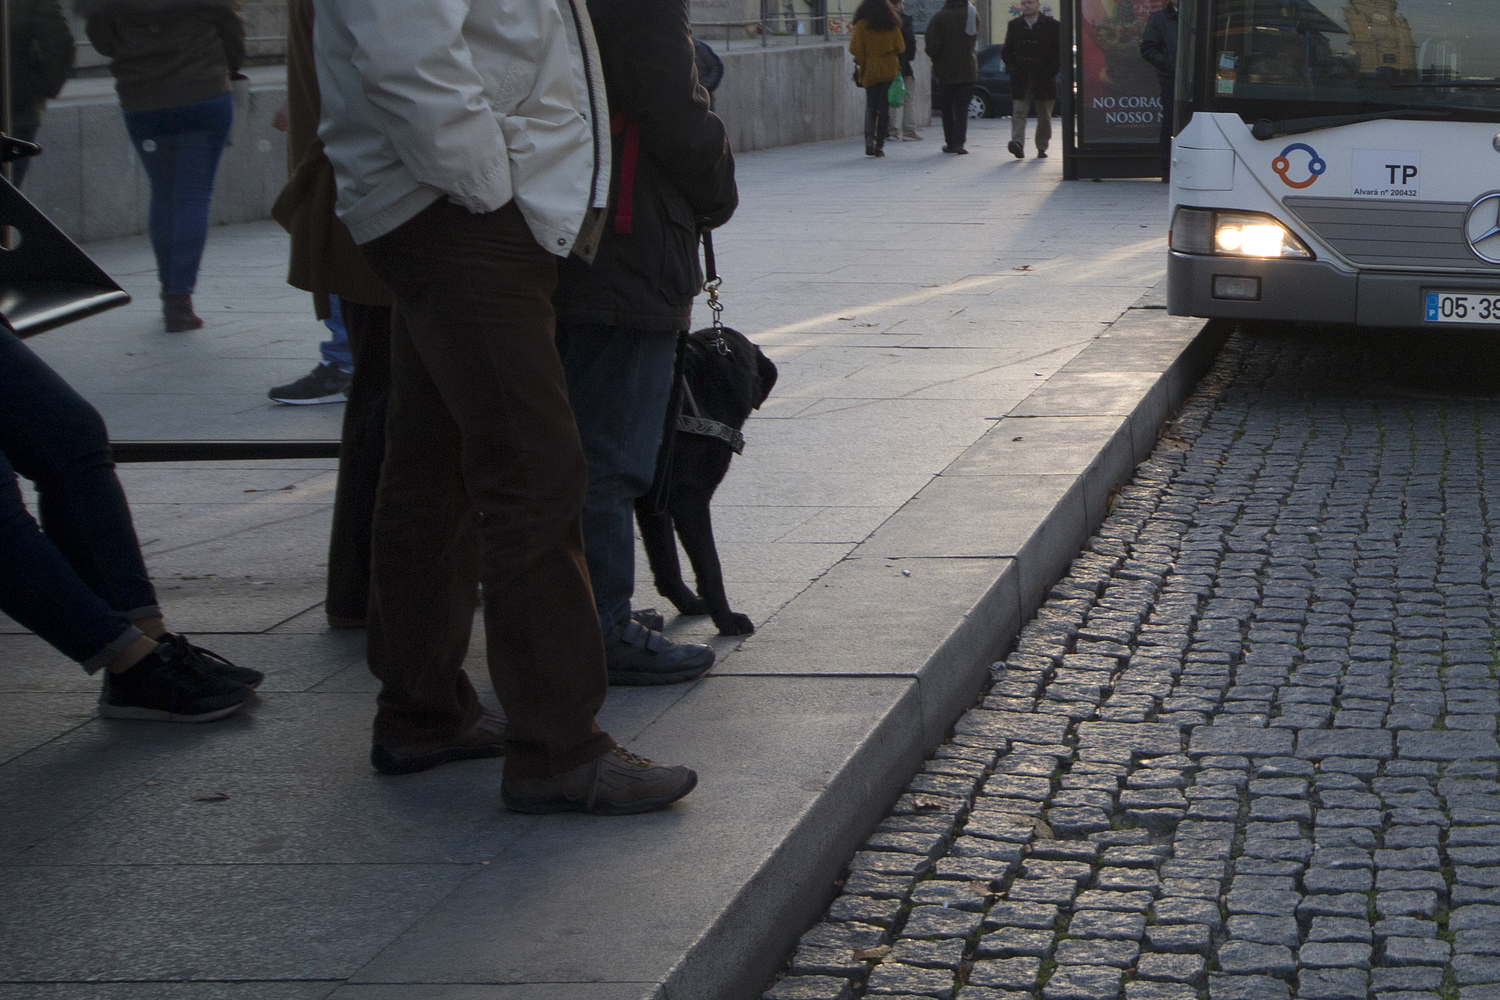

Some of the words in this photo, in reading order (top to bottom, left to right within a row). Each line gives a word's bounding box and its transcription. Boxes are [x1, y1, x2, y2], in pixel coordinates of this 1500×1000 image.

[1092, 96, 1116, 109] NO
[1105, 111, 1154, 123] NOSSO
[1385, 164, 1418, 185] TP
[1353, 188, 1379, 196] Alvará
[1390, 189, 1418, 197] 200432
